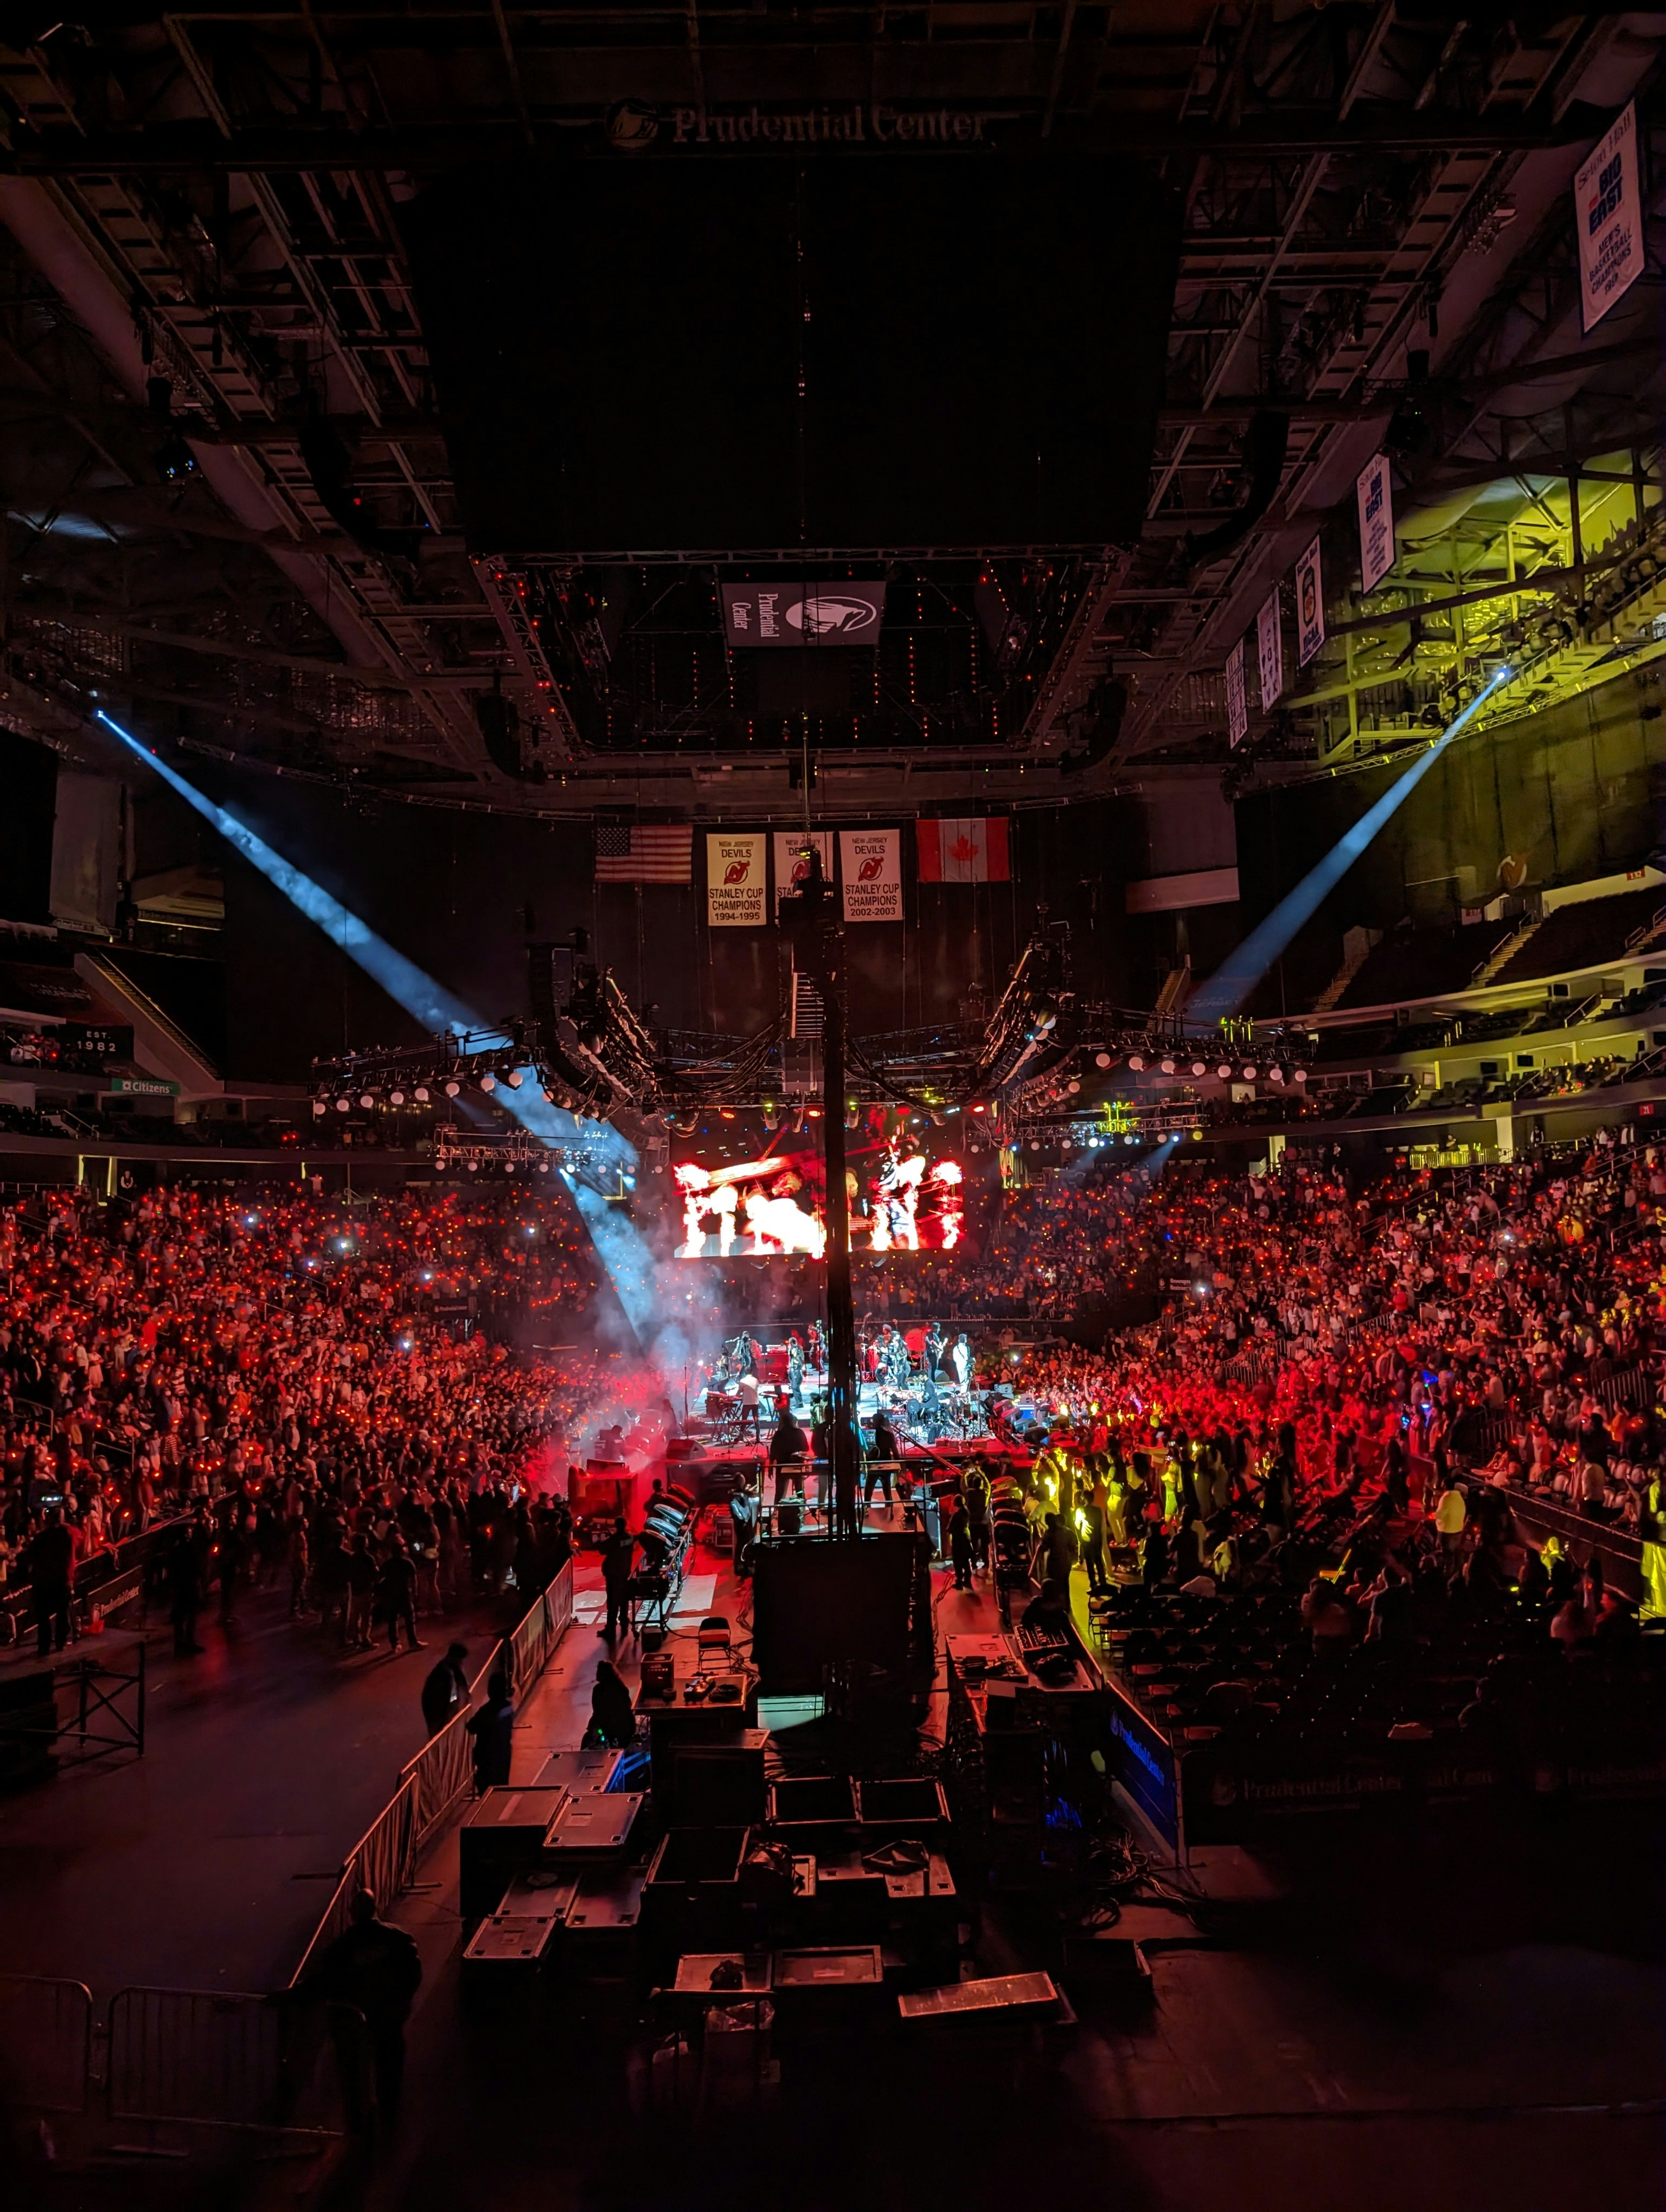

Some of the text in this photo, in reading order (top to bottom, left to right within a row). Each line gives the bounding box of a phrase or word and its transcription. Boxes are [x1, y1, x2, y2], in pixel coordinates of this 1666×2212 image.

[672, 105, 984, 142] Prudential Center
[1578, 111, 1630, 191] Seton Hall
[1590, 175, 1622, 236] EAST
[1590, 228, 1632, 282] BASKETBALL
[731, 602, 753, 630] Center
[758, 593, 780, 638] Prudential
[721, 849, 752, 858] DEVILS
[855, 845, 885, 854] DEVILS
[709, 888, 764, 898] STANLEY CUP
[845, 883, 899, 895] STANLEY CUP
[712, 900, 761, 910] CHAMPIONS
[848, 895, 897, 906] CHAMPIONS
[715, 912, 760, 921] 1994-1995
[850, 907, 895, 916] 2002-2003
[86, 1030, 111, 1039] EST.
[77, 1040, 116, 1052] 1982
[132, 1082, 170, 1094] Citizens
[1119, 1719, 1165, 1786] Prudential Center
